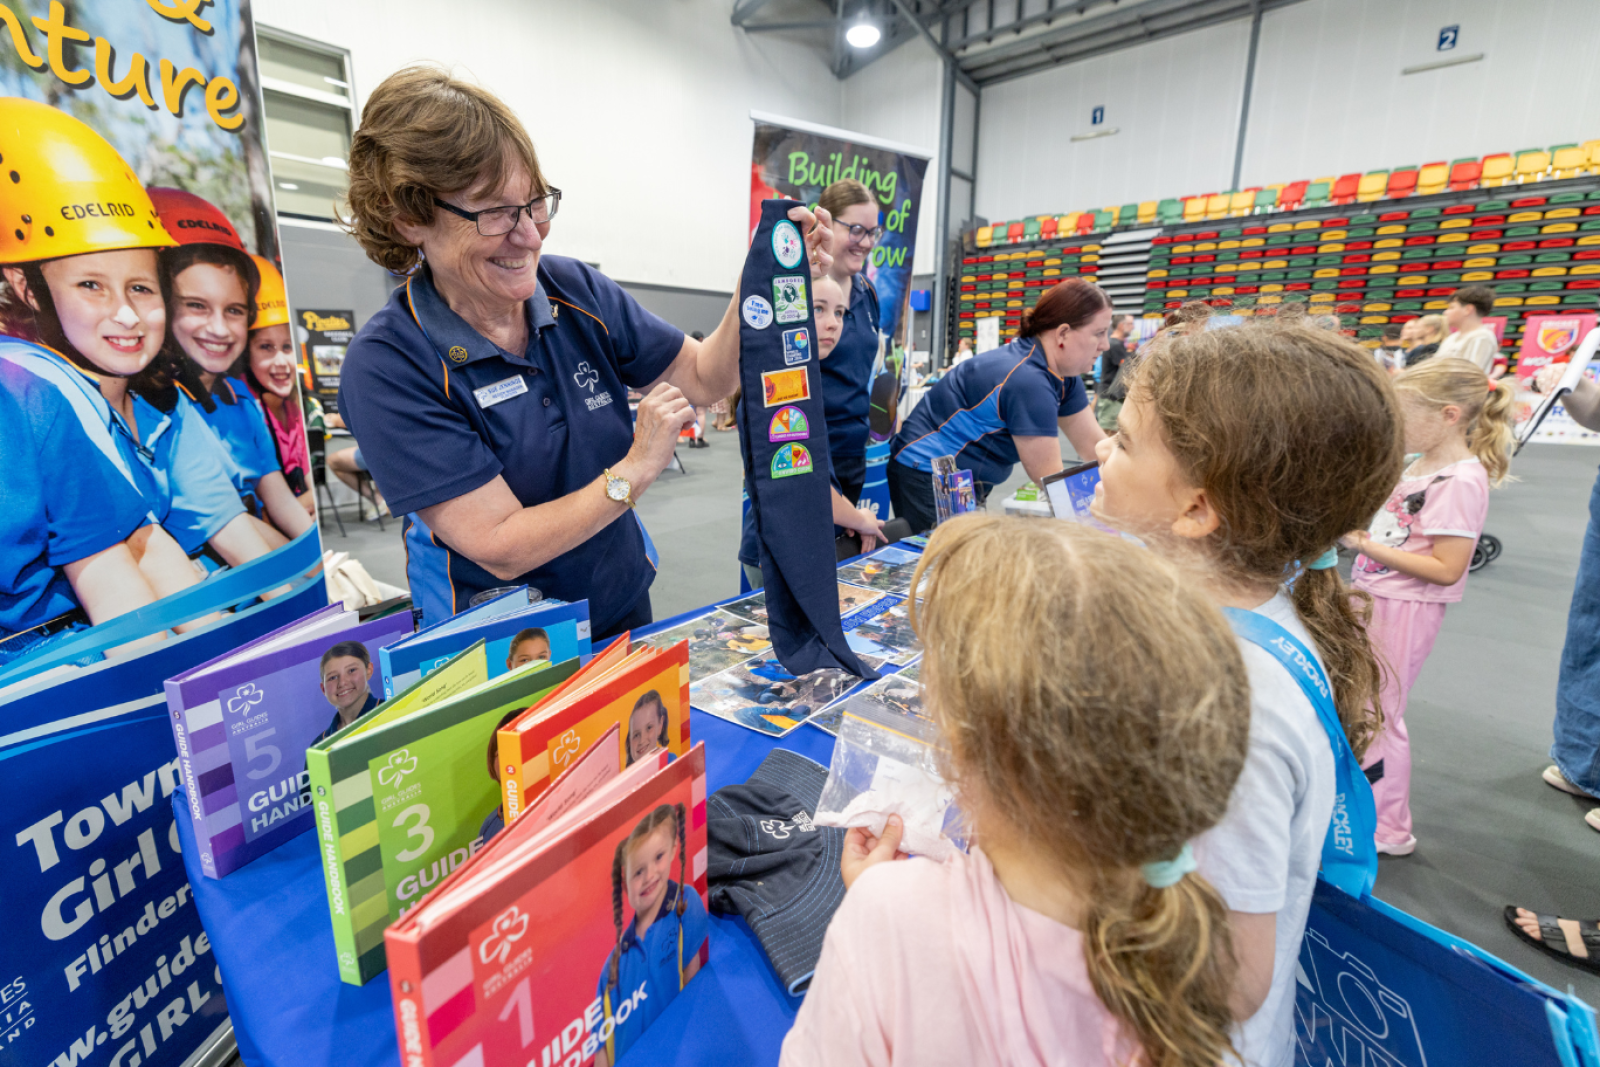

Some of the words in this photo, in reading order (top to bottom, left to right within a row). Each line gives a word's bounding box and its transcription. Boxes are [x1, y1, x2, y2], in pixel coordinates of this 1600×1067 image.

[60, 202, 135, 220] EDELRID
[886, 199, 911, 233] of
[175, 722, 190, 758] GUIDE
[243, 727, 283, 780] 5
[182, 759, 202, 821] HANDBOOK
[506, 779, 519, 819] GUIDE
[318, 801, 333, 842] GUIDE
[392, 803, 435, 863] 3
[41, 827, 161, 941] Girl
[325, 843, 345, 916] HANDBOOK
[396, 835, 484, 901] GUIDE
[498, 976, 536, 1049] 1
